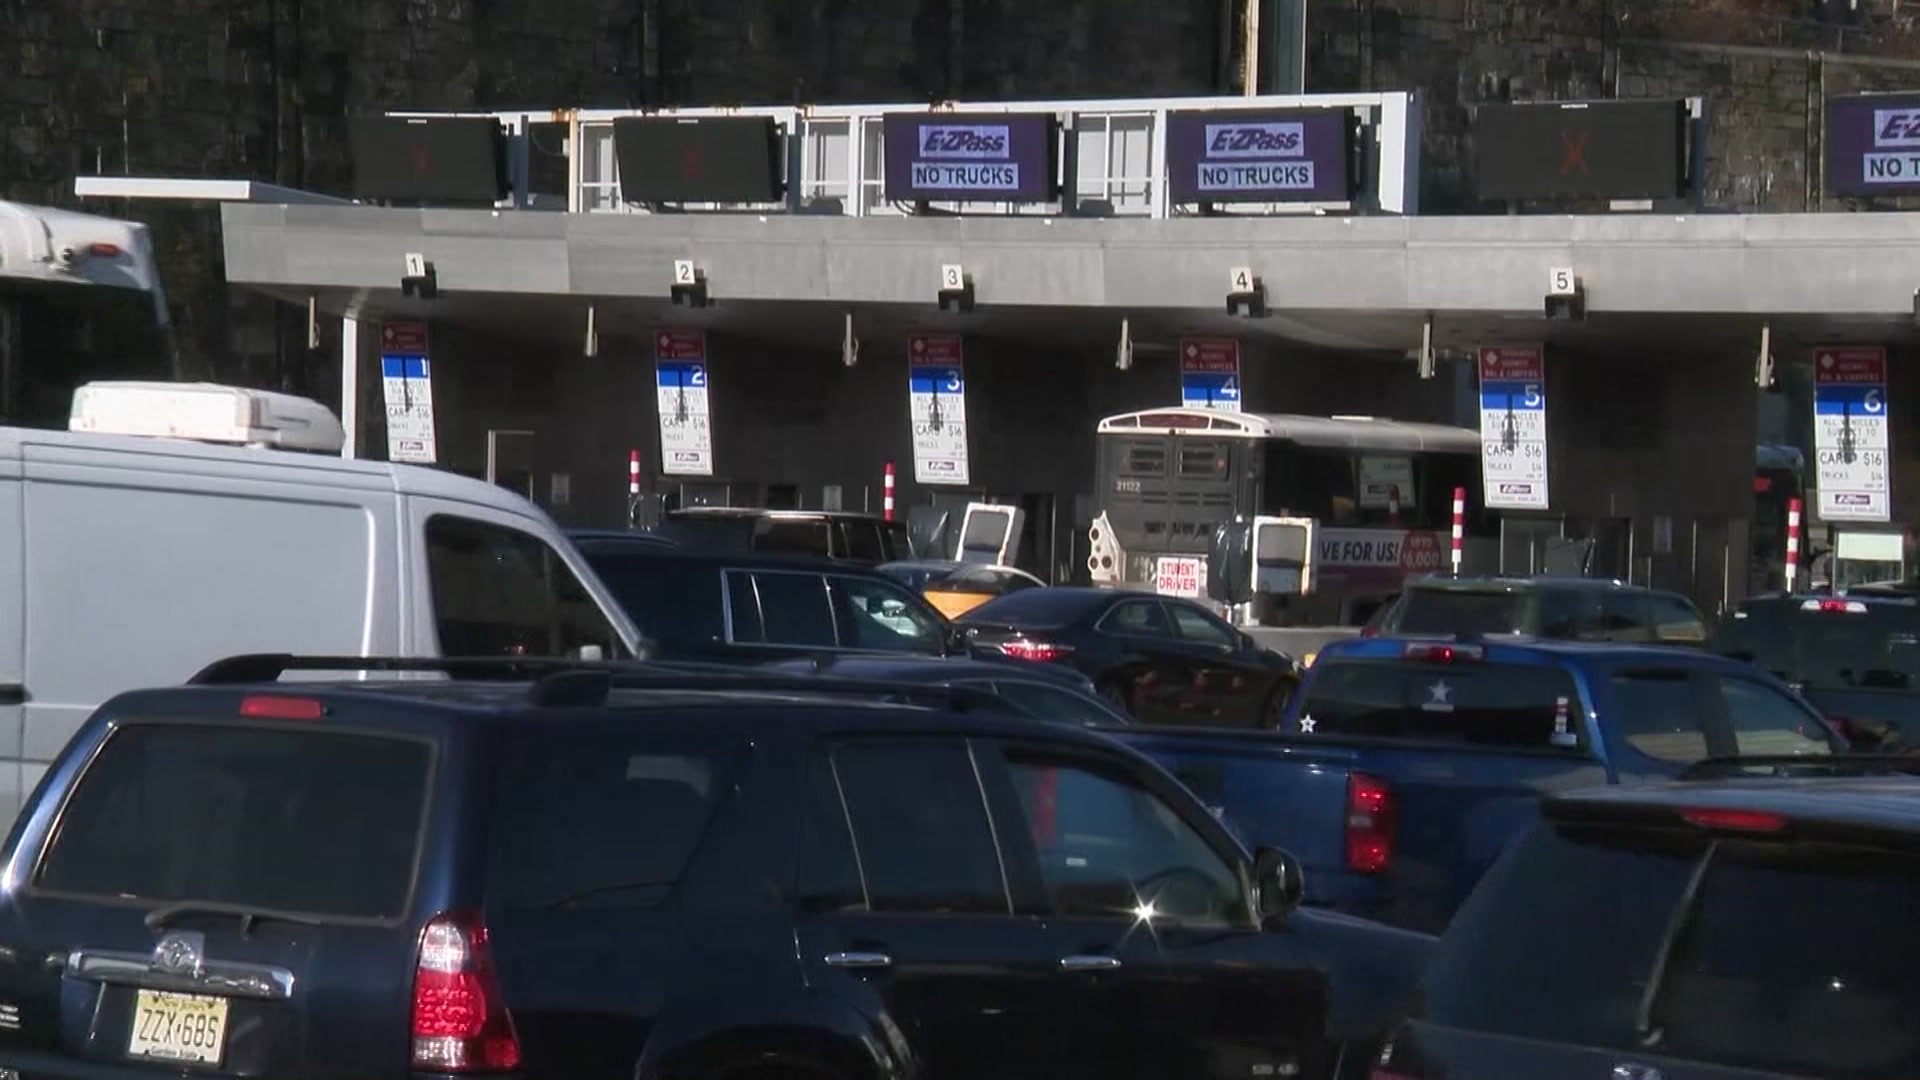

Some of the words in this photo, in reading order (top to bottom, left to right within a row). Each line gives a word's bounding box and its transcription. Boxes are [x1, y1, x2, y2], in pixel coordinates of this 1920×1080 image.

[916, 167, 940, 184] NO
[945, 166, 1014, 185] TRUCKS
[1203, 168, 1228, 185] NO
[1234, 166, 1309, 184] TRUCKS
[1870, 158, 1902, 177] NO
[680, 264, 690, 281] 2
[948, 268, 958, 286] 3
[1236, 271, 1248, 289] 4
[1556, 271, 1568, 290] 5
[691, 365, 704, 385] 2
[947, 370, 960, 391] 3
[1220, 376, 1237, 398] 4
[1525, 384, 1540, 407] 5
[1864, 388, 1881, 413] 6
[1525, 444, 1542, 459] $16
[1820, 451, 1850, 465] CAR
[1863, 451, 1883, 466] $16
[1343, 541, 1373, 560] FOR
[1376, 541, 1399, 562] US!
[1160, 562, 1194, 576] STUDENT
